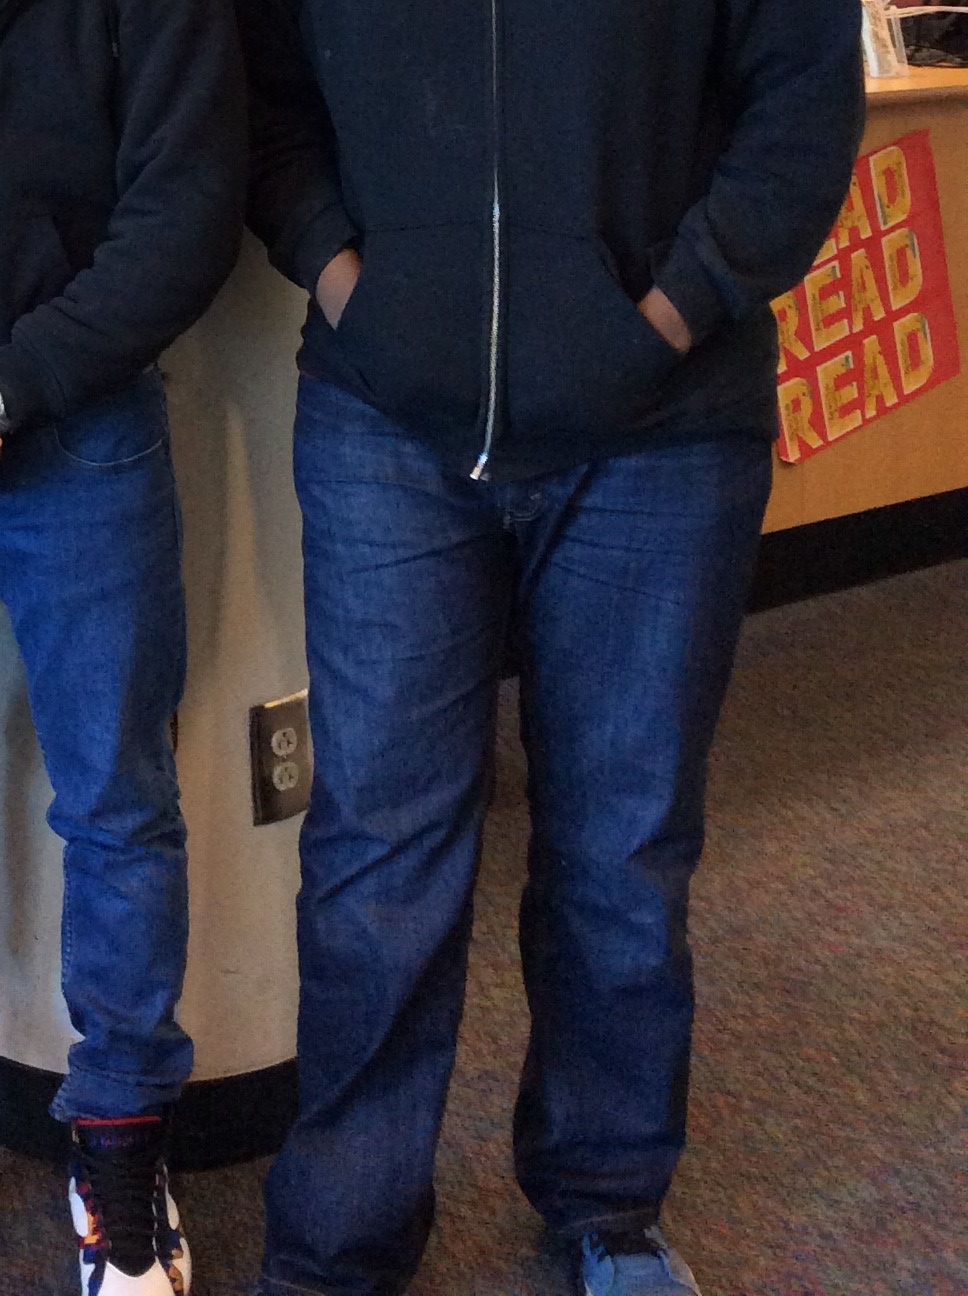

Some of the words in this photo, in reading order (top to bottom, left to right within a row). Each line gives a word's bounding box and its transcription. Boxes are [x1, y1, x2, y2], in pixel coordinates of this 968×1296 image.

[812, 145, 912, 267] AD
[769, 227, 924, 375] READ
[777, 312, 935, 463] READ
